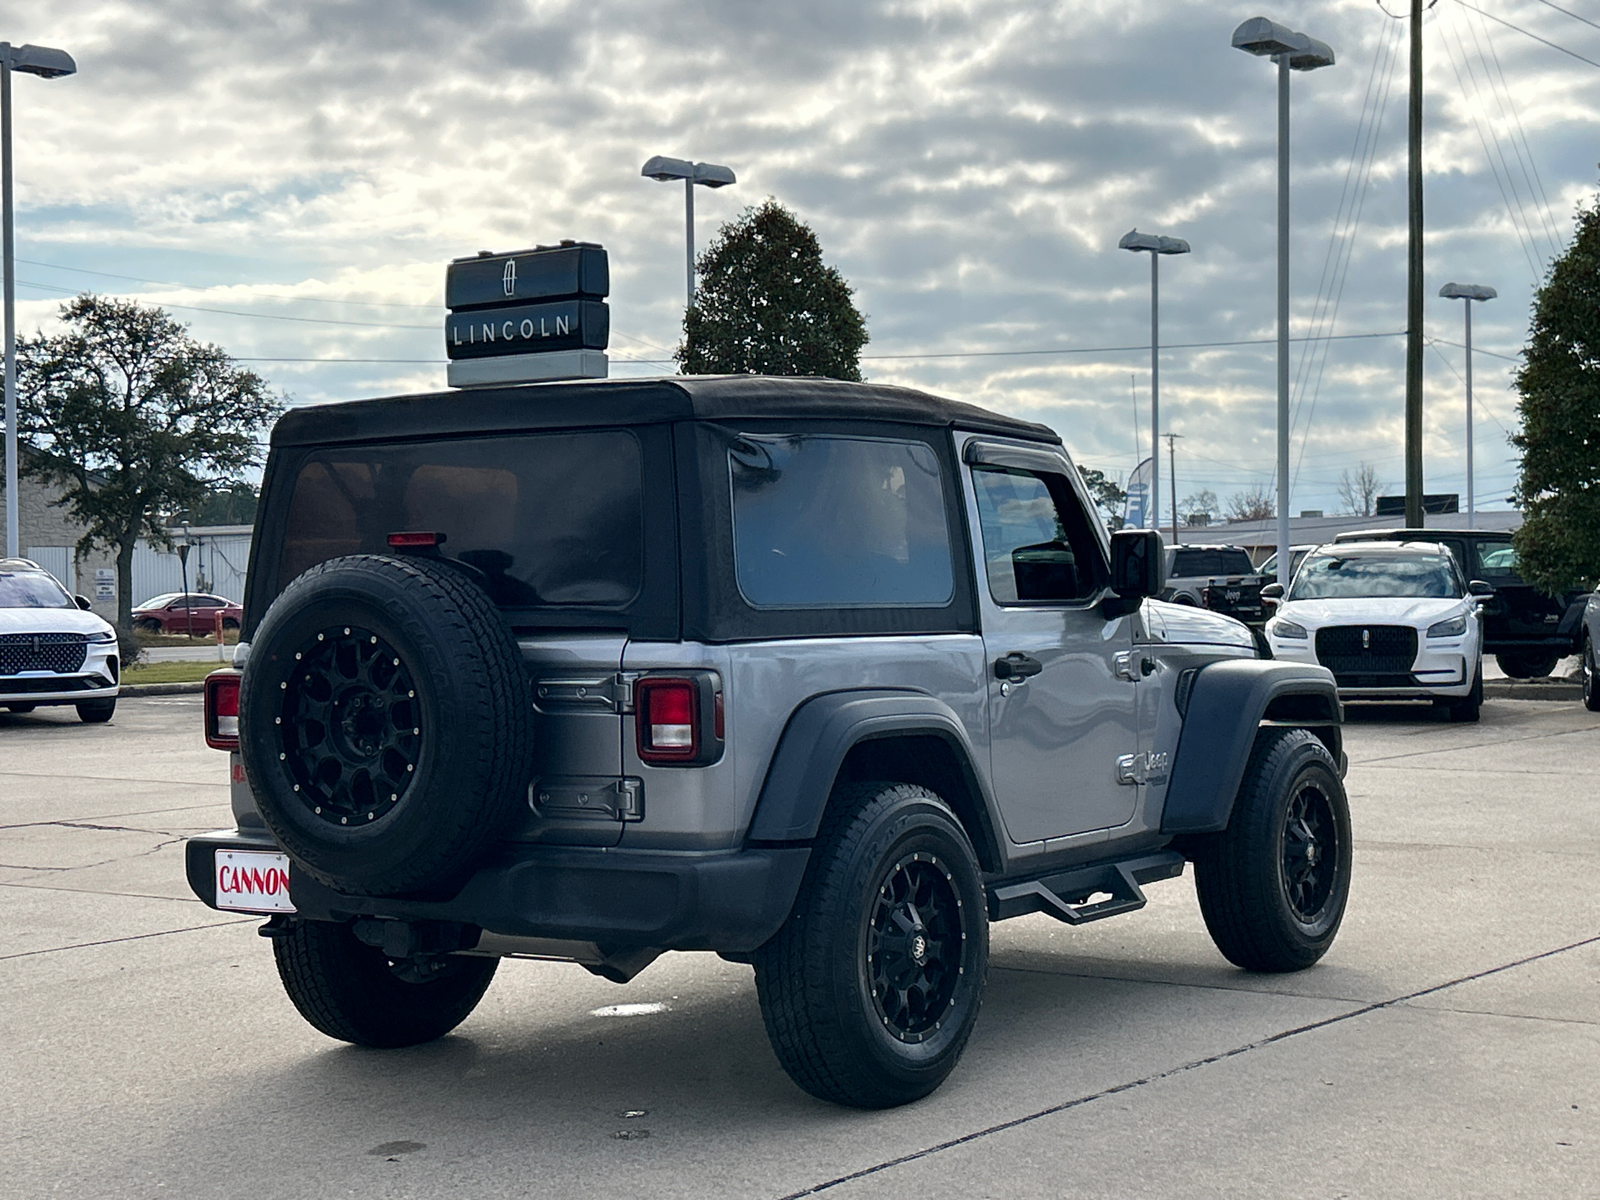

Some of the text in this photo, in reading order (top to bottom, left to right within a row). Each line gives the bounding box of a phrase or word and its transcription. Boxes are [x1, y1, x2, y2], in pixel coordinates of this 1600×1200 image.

[454, 315, 569, 346] LINCOLN
[1145, 751, 1168, 771] Jeep
[219, 865, 289, 896] CANNON
